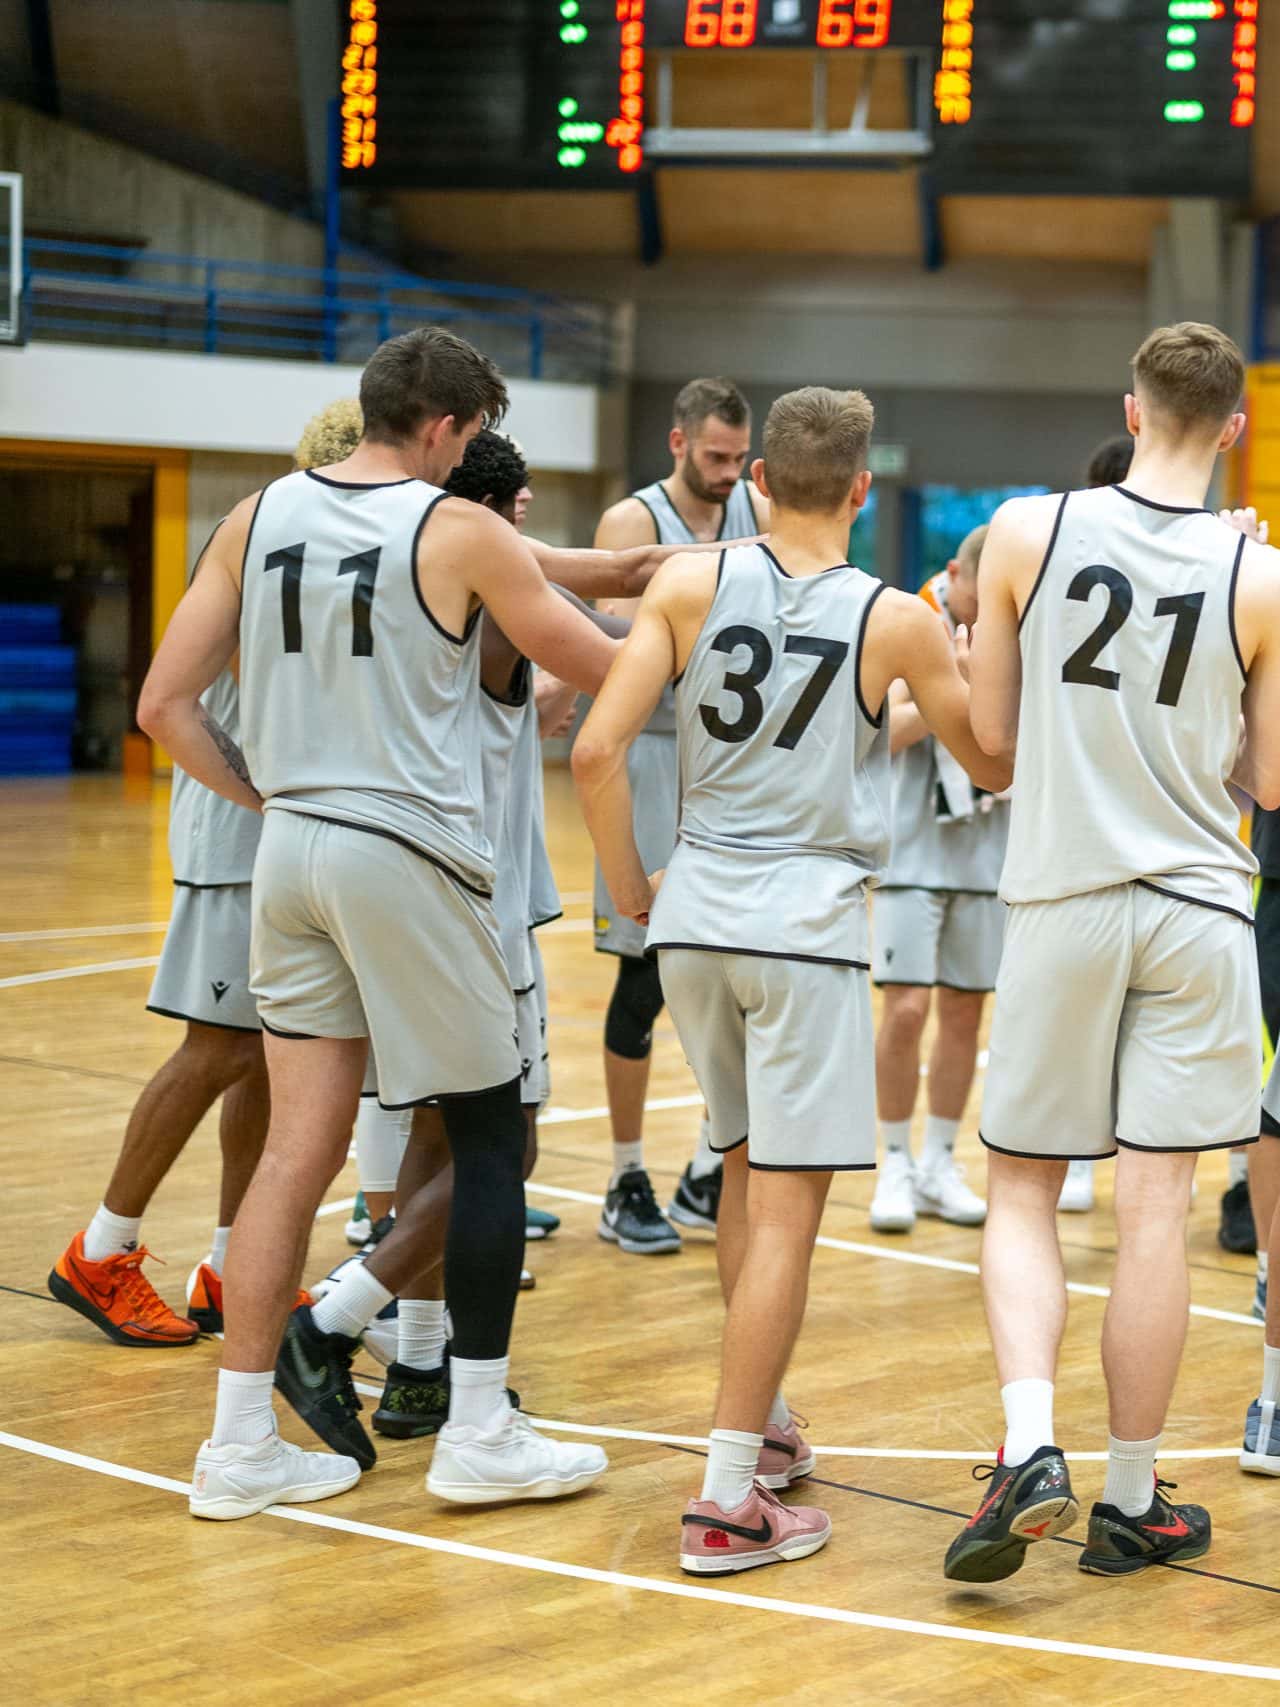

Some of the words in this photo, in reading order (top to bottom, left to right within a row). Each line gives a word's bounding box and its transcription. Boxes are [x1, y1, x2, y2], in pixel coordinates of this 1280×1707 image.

[684, 0, 757, 47] 68
[816, 0, 892, 47] 69
[264, 541, 382, 657] 11
[1061, 564, 1206, 708] 21
[699, 624, 850, 751] 37
